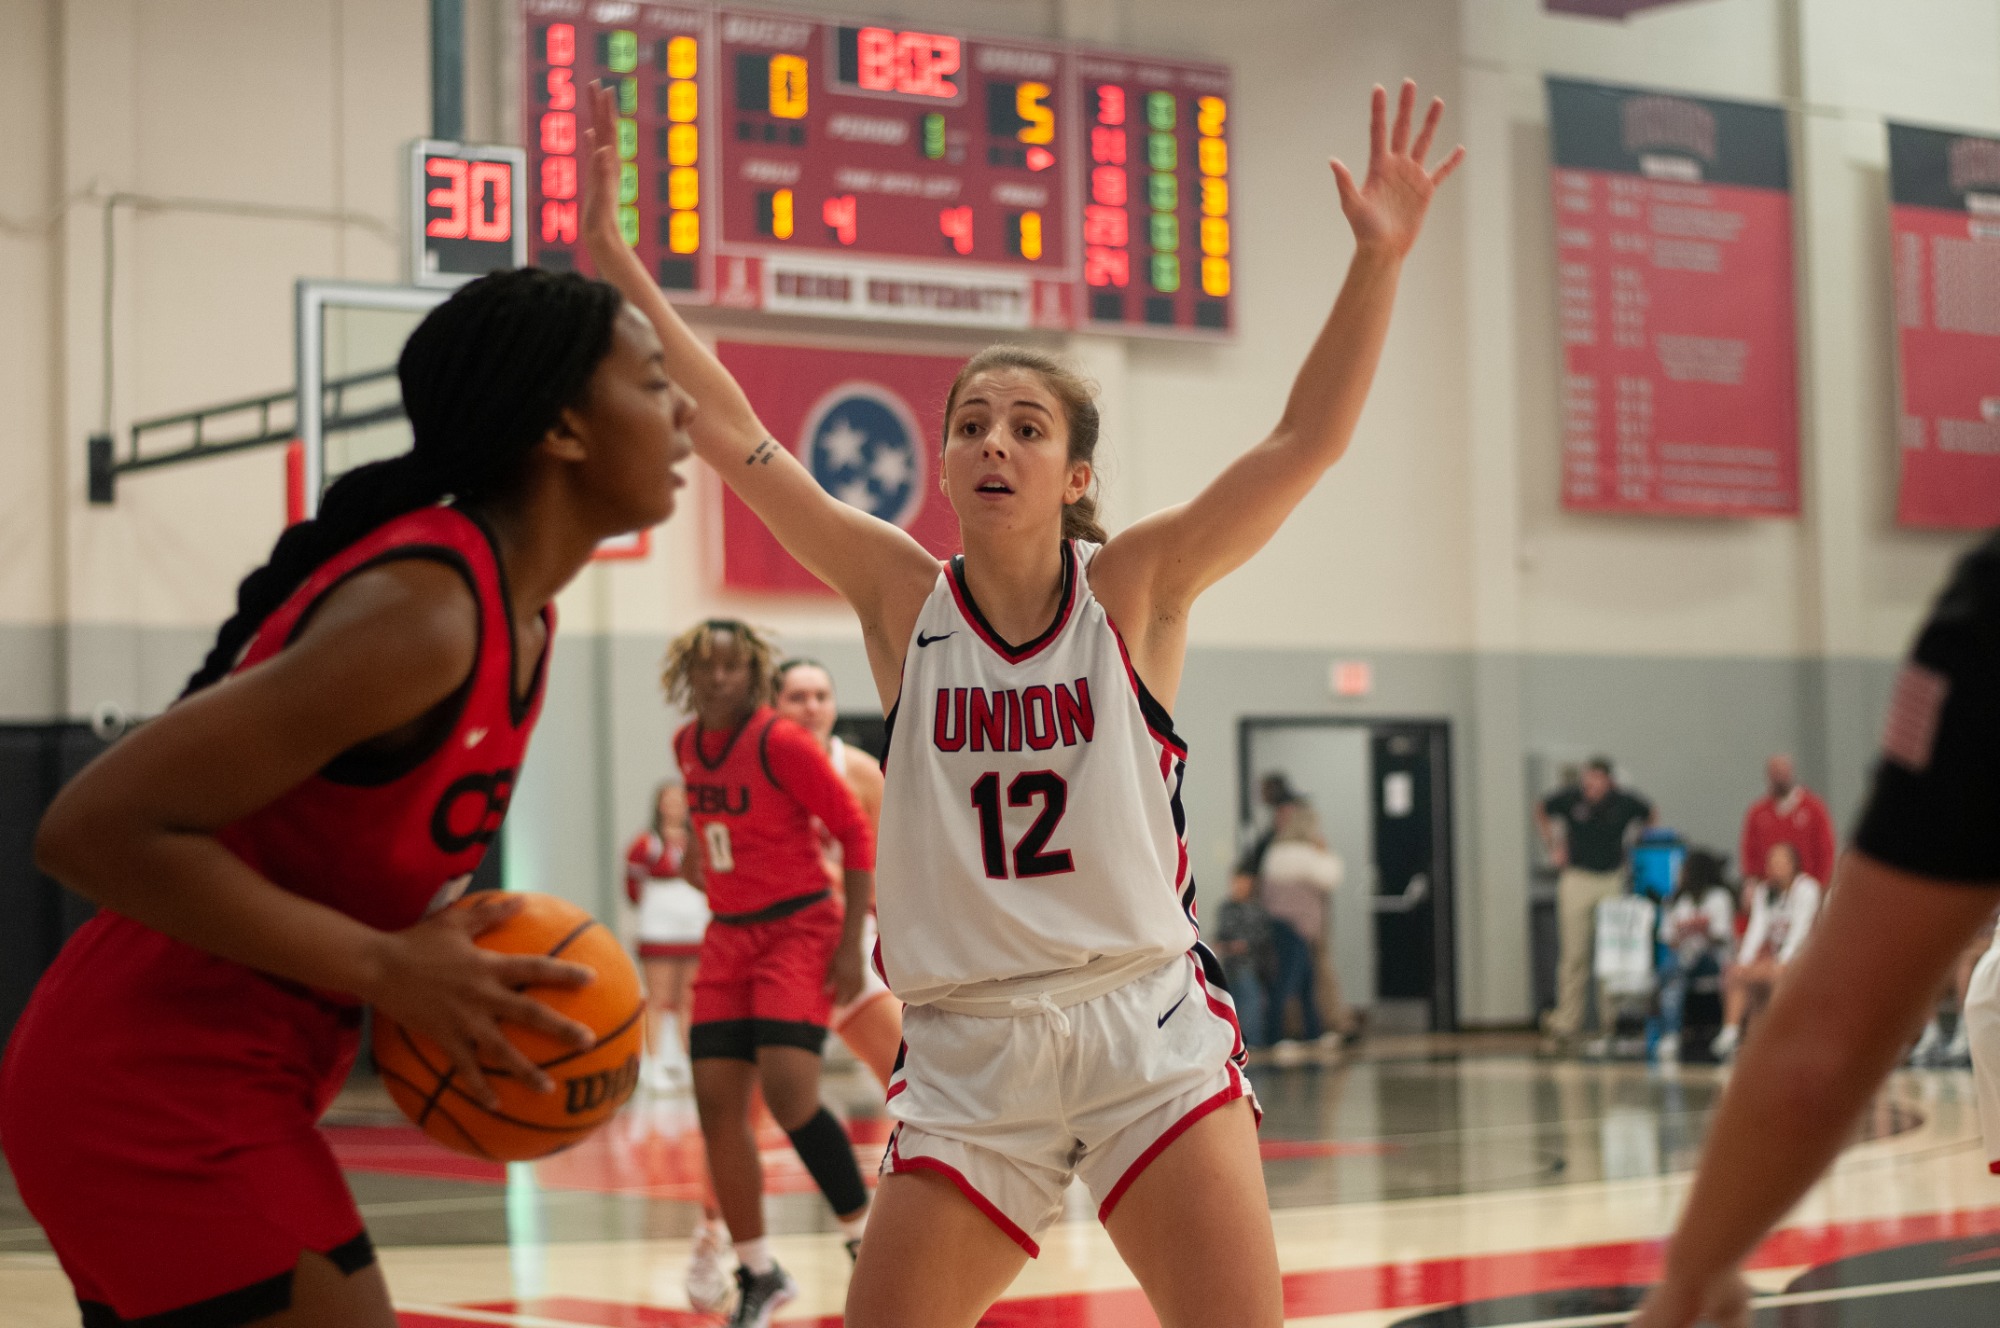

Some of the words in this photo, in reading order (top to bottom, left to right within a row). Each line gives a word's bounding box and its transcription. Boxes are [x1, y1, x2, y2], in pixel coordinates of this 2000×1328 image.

[768, 54, 809, 120] 0
[857, 27, 961, 98] 8:02
[1015, 82, 1055, 145] 5
[425, 157, 511, 242] 30
[772, 188, 794, 240] 1
[823, 194, 857, 246] 4
[940, 205, 974, 255] 4
[1020, 210, 1042, 261] 1
[934, 677, 1095, 753] UNION
[704, 821, 735, 874] 0
[970, 769, 1076, 881] 12
